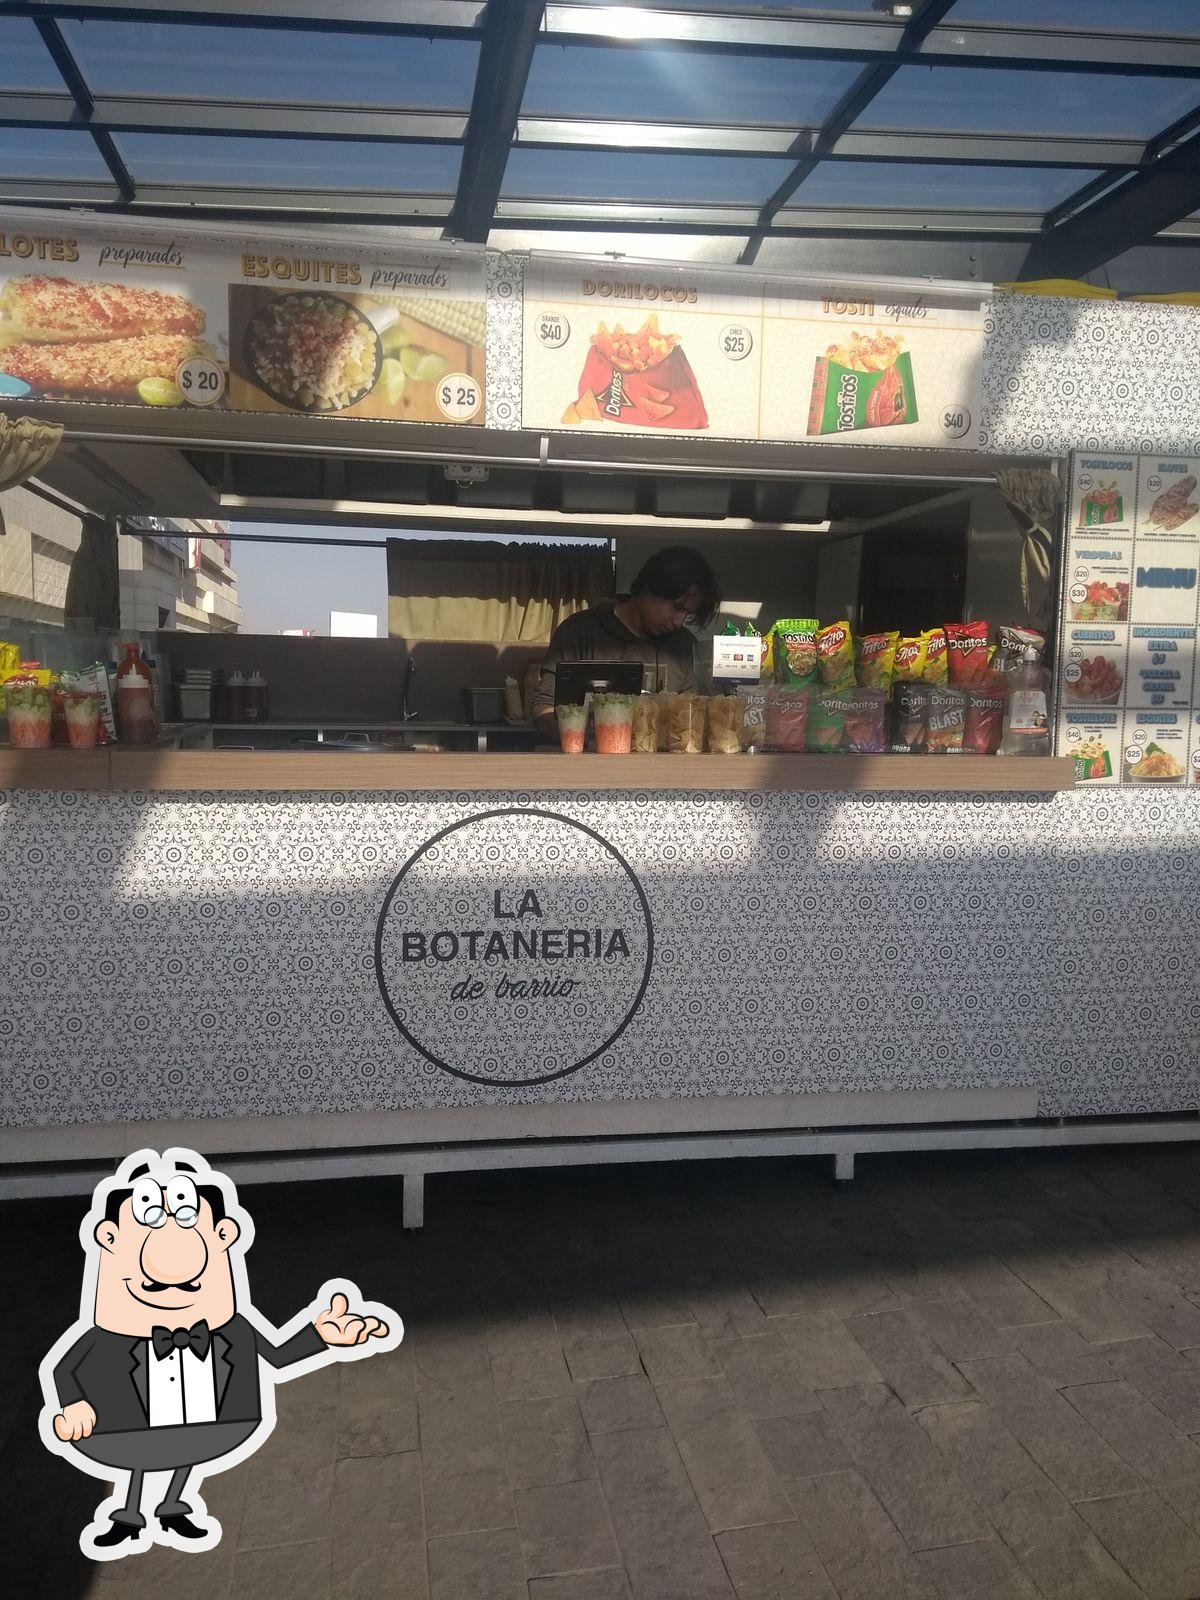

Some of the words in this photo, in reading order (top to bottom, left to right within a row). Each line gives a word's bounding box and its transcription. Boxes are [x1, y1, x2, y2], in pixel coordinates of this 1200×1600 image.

[99, 240, 183, 268] preparados
[241, 254, 362, 285] ESQUITES
[370, 264, 448, 290] preparados
[582, 279, 697, 303] DORILOCOS
[822, 296, 875, 316] TOSTI
[540, 322, 561, 340] $40
[724, 336, 744, 353] $25
[604, 369, 623, 417] Doritos
[944, 412, 963, 429] $40
[1136, 567, 1197, 589] MENU
[949, 637, 988, 650] Doritos
[1065, 669, 1080, 677] $25
[931, 695, 966, 706] Doritos
[1127, 750, 1141, 758] $25
[494, 889, 543, 919] LA
[402, 929, 631, 962] BOTANERIA
[451, 974, 486, 1001] de
[494, 974, 581, 999] barrio
